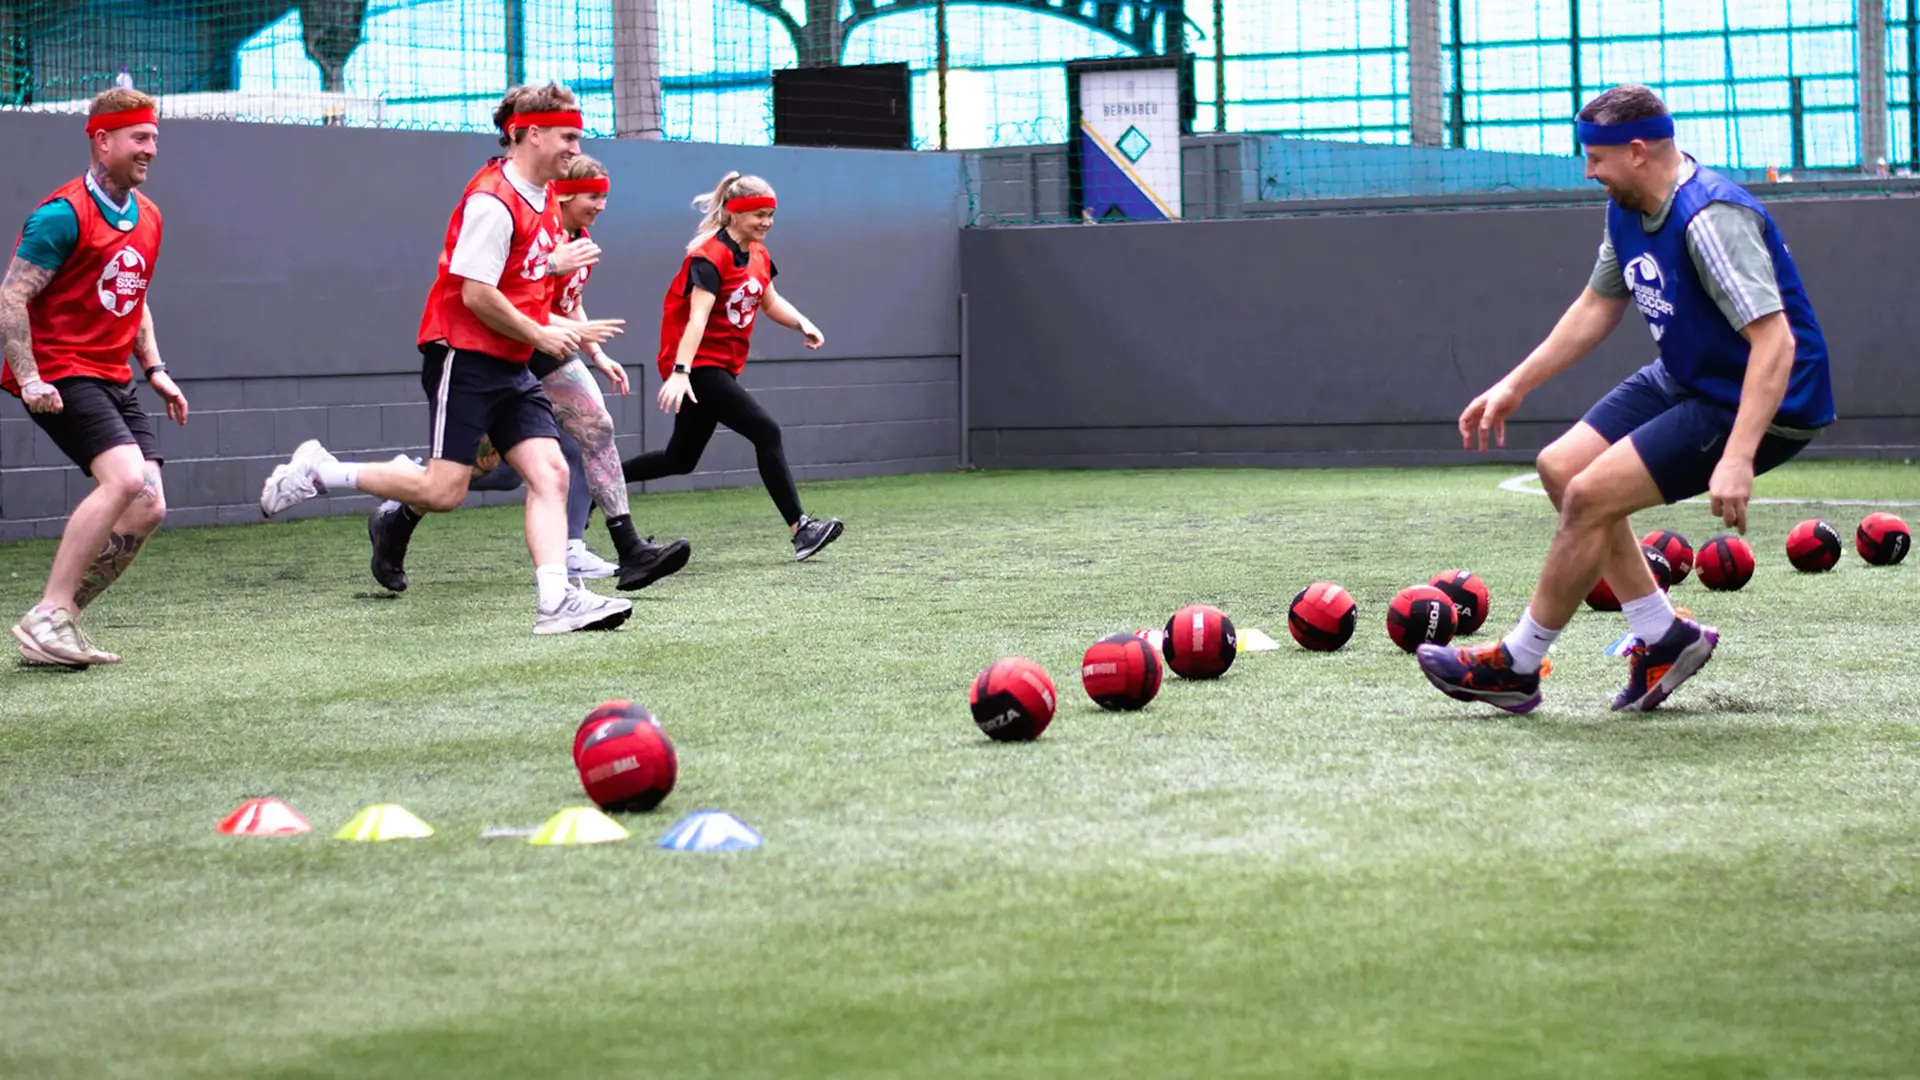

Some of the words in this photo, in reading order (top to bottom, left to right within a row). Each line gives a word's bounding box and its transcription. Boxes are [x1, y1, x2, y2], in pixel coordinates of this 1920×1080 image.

[116, 279, 147, 289] SOCCE
[1635, 291, 1674, 316] SOCCER
[1425, 601, 1440, 643] FORZ
